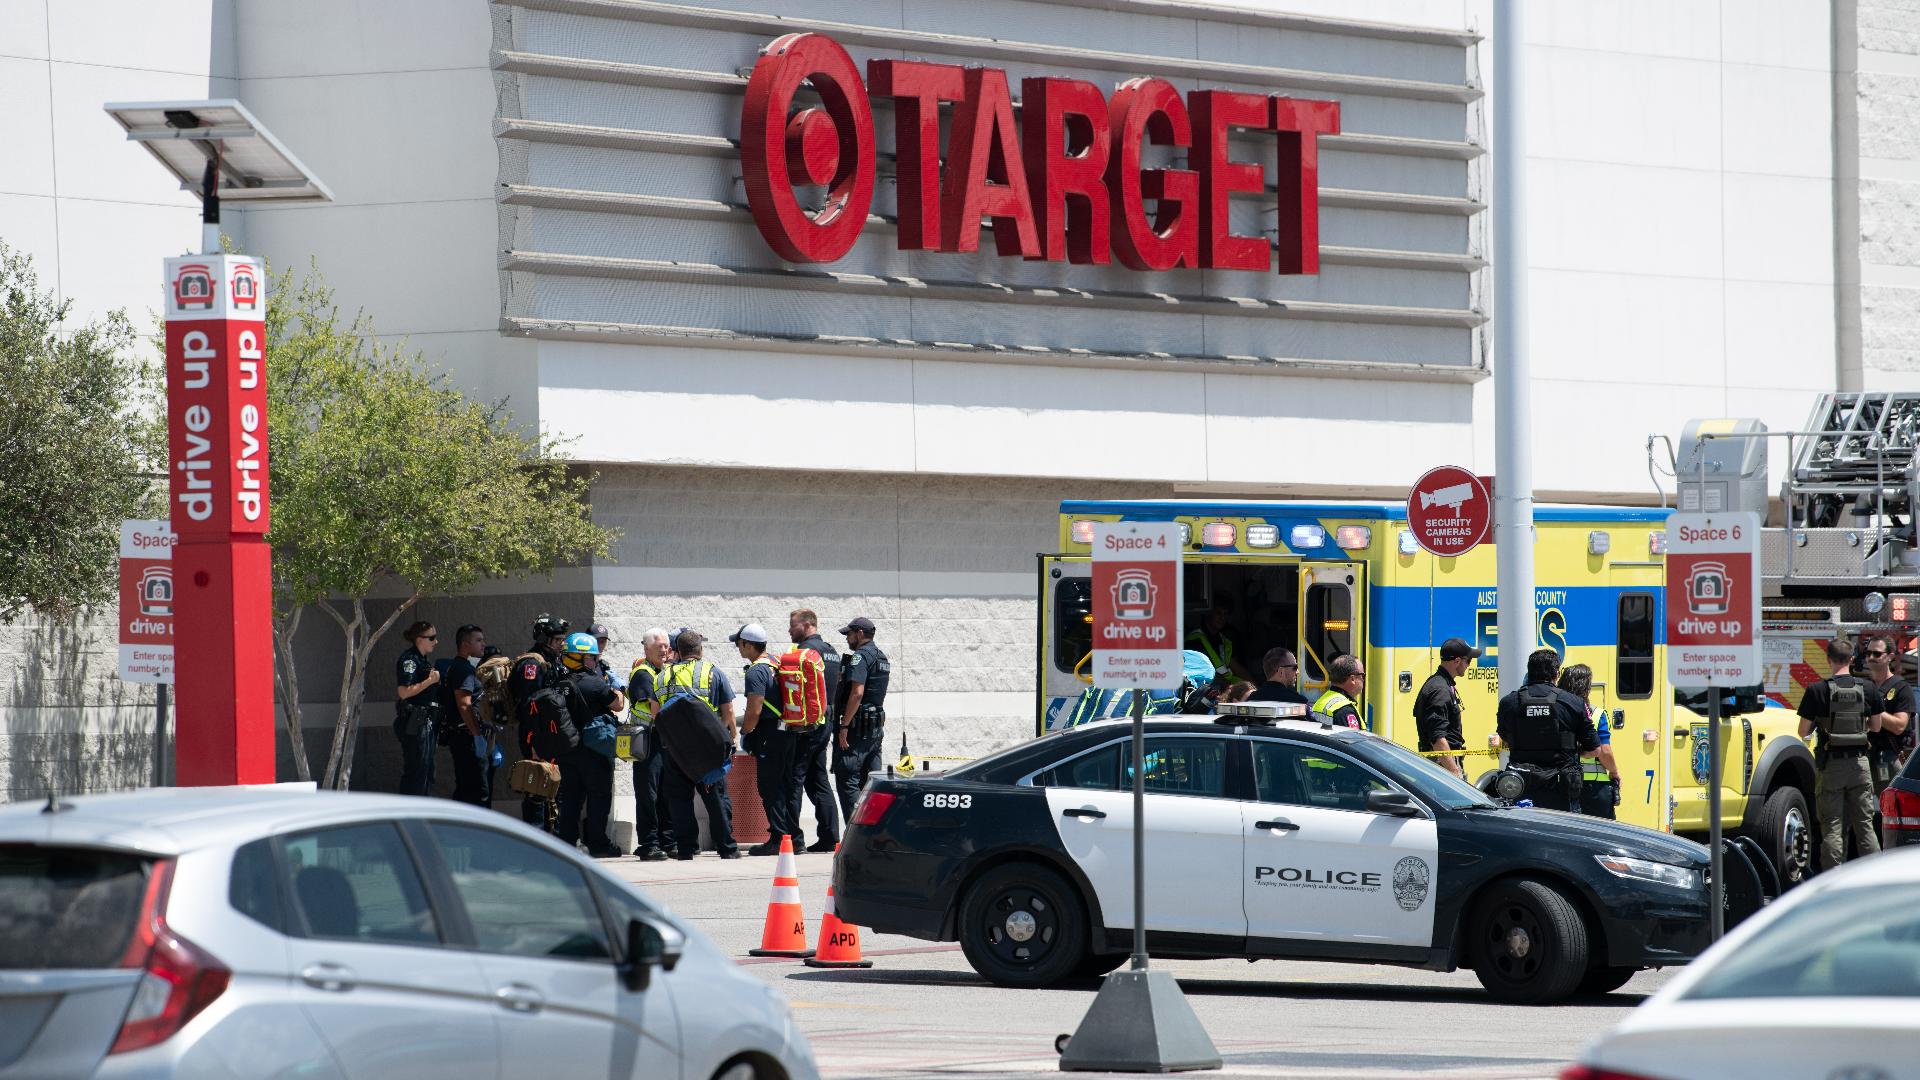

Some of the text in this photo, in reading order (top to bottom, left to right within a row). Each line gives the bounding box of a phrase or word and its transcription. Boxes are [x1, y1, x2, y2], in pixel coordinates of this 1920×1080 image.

[867, 57, 1341, 276] TARGET
[178, 330, 217, 521] drive up
[236, 330, 262, 521] drive up
[1425, 518, 1472, 527] SECURITY
[1425, 528, 1472, 537] CAMERAS
[1680, 525, 1742, 543] Space 6
[132, 532, 178, 550] Space
[1105, 534, 1167, 552] Space 4
[1433, 537, 1464, 546] IN USE
[1535, 590, 1567, 606] COUNTY
[129, 618, 165, 635] drive
[1103, 622, 1167, 642] drive up
[1678, 618, 1742, 637] drive up
[1475, 607, 1567, 668] ES
[133, 651, 174, 663] Enter spa
[1108, 656, 1161, 668] Enter space
[1683, 652, 1737, 665] Enter space
[128, 664, 160, 673] number
[162, 665, 170, 673] in
[1103, 670, 1167, 680] number in app
[1468, 667, 1498, 680] EMERGEN
[1678, 666, 1742, 679] number in app
[1526, 708, 1550, 717] EMS
[1645, 769, 1655, 804] 7
[923, 793, 972, 809] 8693
[1255, 866, 1382, 887] POLICE
[829, 932, 856, 947] APD
